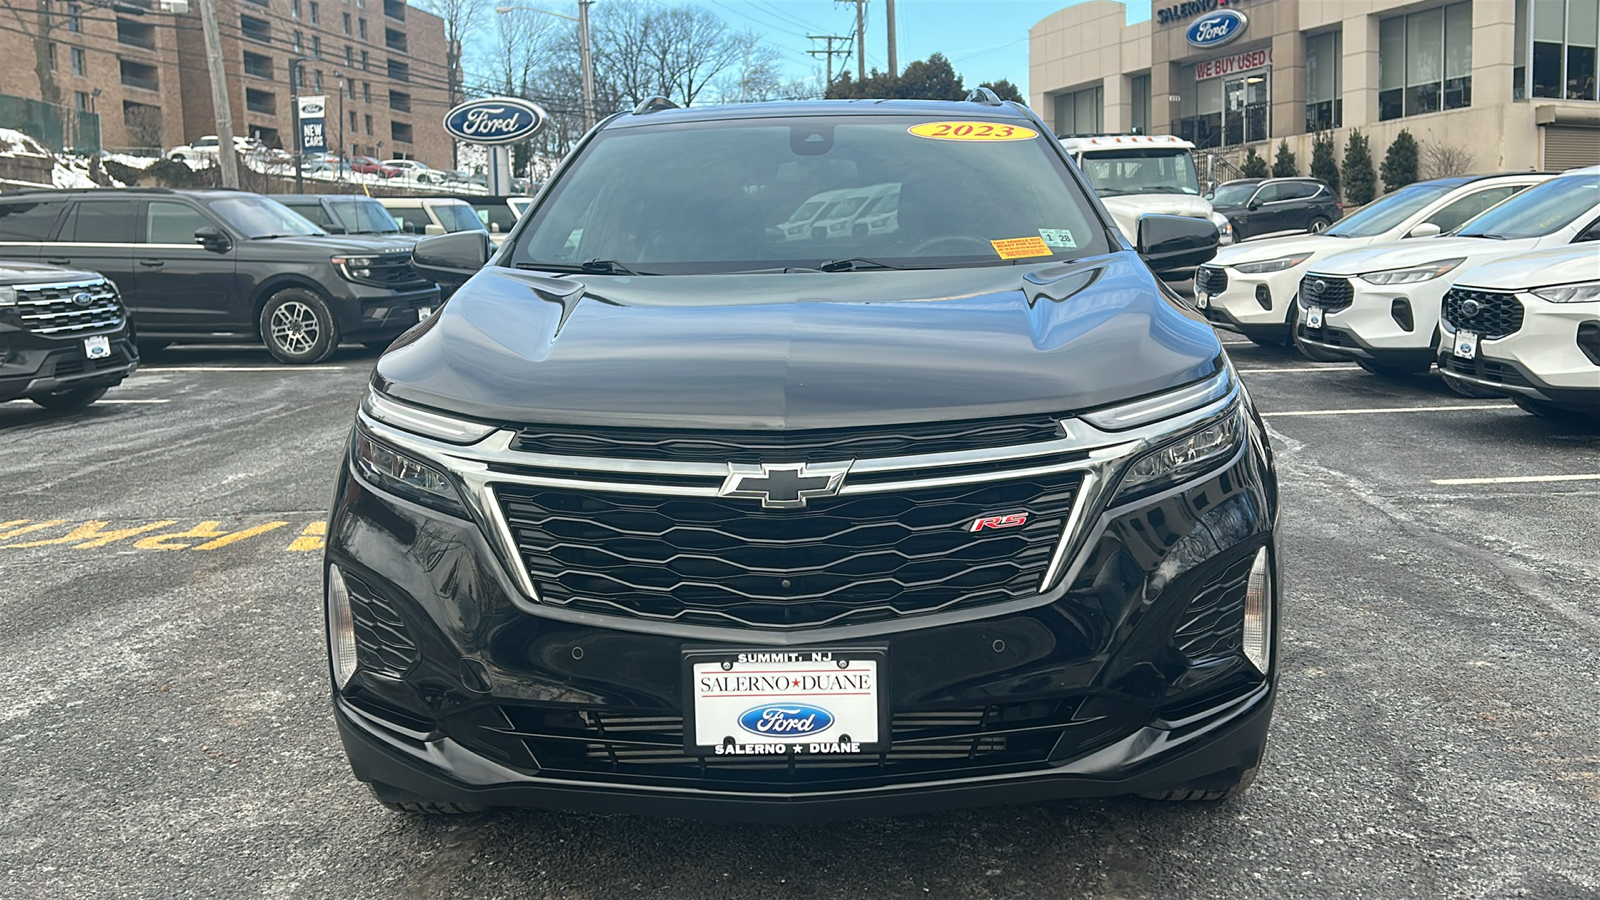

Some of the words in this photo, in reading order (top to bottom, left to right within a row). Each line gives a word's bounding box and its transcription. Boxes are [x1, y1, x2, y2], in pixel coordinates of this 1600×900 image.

[1157, 0, 1217, 24] SALERNO
[1196, 18, 1229, 42] Ford
[1196, 62, 1212, 79] WE
[1215, 56, 1235, 75] BUY
[1238, 50, 1266, 70] USED
[304, 124, 322, 137] NEW
[462, 108, 520, 134] Ford
[931, 124, 1015, 137] 2023
[304, 136, 324, 147] CARS
[1058, 234, 1071, 242] 28
[970, 512, 1029, 533] RS
[737, 653, 803, 663] SUMMIT,
[812, 652, 832, 662] NJ
[700, 676, 790, 693] SALERNO
[801, 674, 871, 691] DUANE
[756, 707, 816, 732] Ford
[714, 744, 786, 755] SALERNO
[809, 743, 861, 754] DUANE
